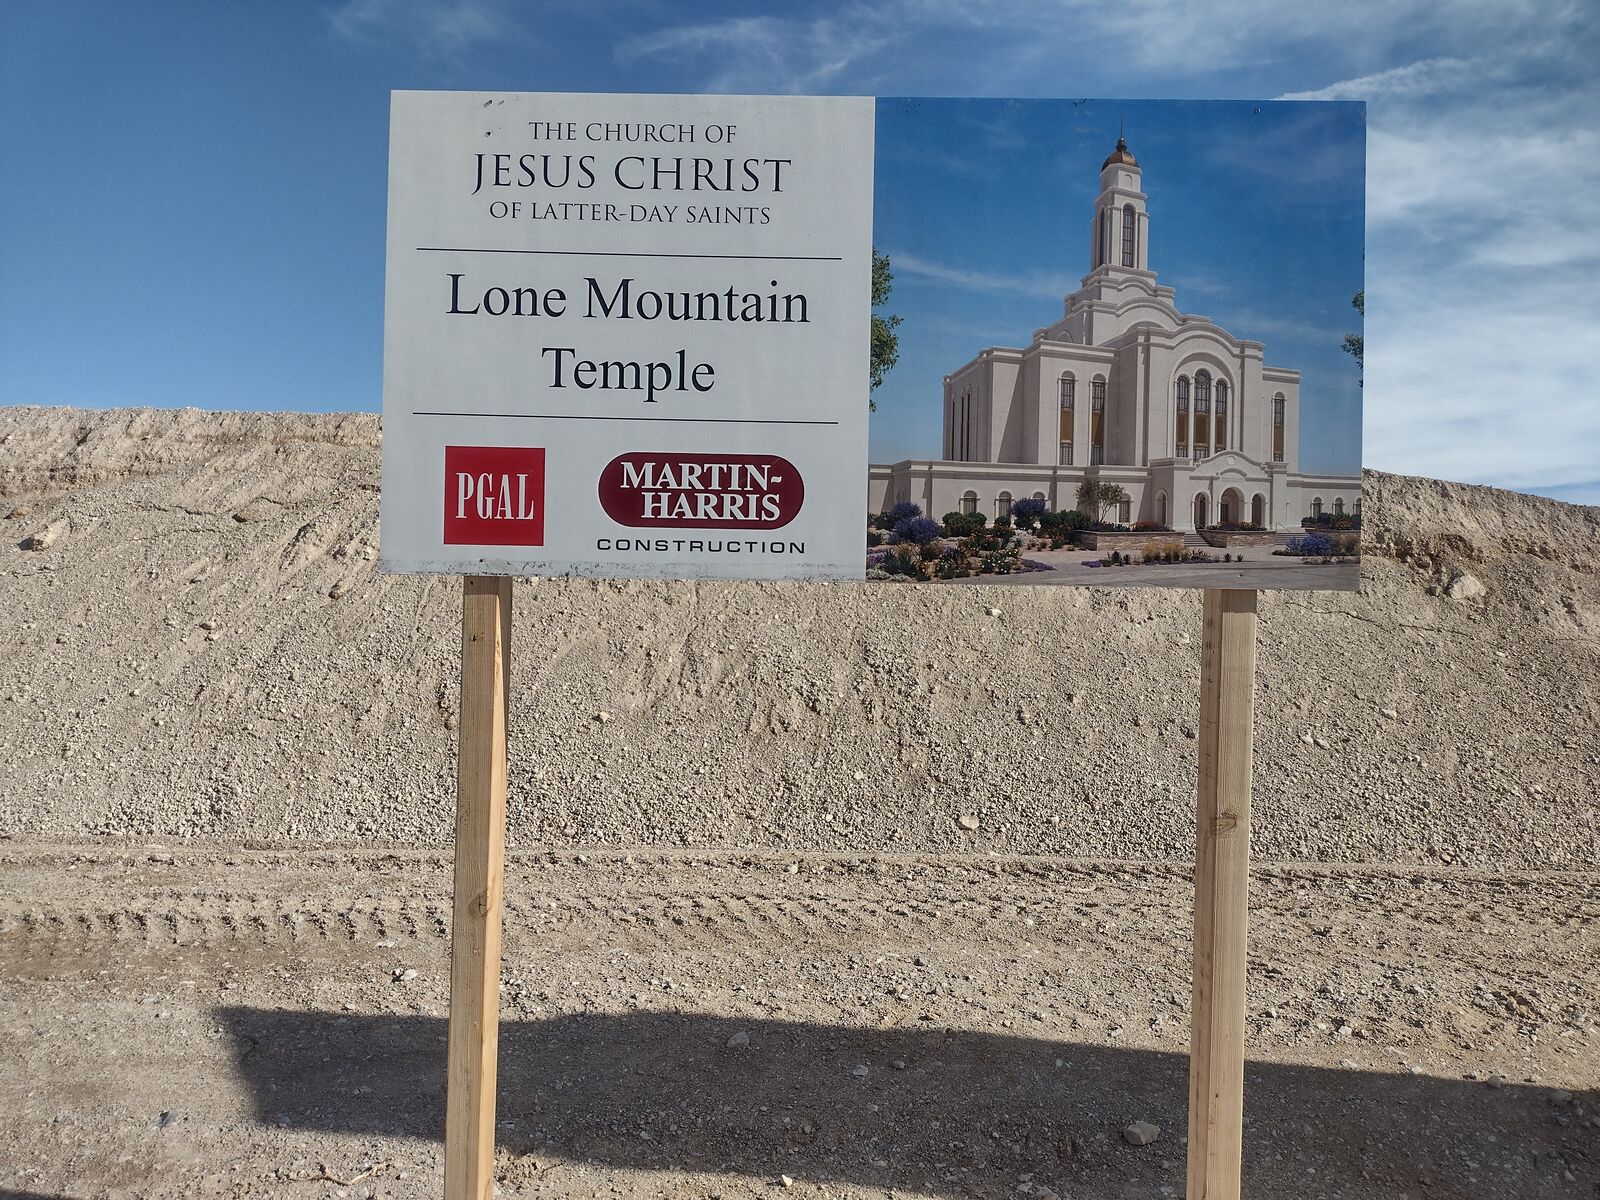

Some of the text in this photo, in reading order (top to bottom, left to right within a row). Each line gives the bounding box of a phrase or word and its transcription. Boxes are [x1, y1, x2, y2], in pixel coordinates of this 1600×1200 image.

[528, 121, 737, 144] THE CHURCH OF
[470, 153, 792, 196] JESUS CHRIST
[489, 201, 771, 225] OF LATTER-DAY SAINTS
[445, 273, 811, 323] Lone Mountain
[541, 347, 715, 403] Temple
[620, 461, 783, 492] MARTIN-
[455, 472, 535, 520] PGAL
[640, 491, 781, 522] HARRIS
[596, 538, 805, 554] CONSTRUCTION
